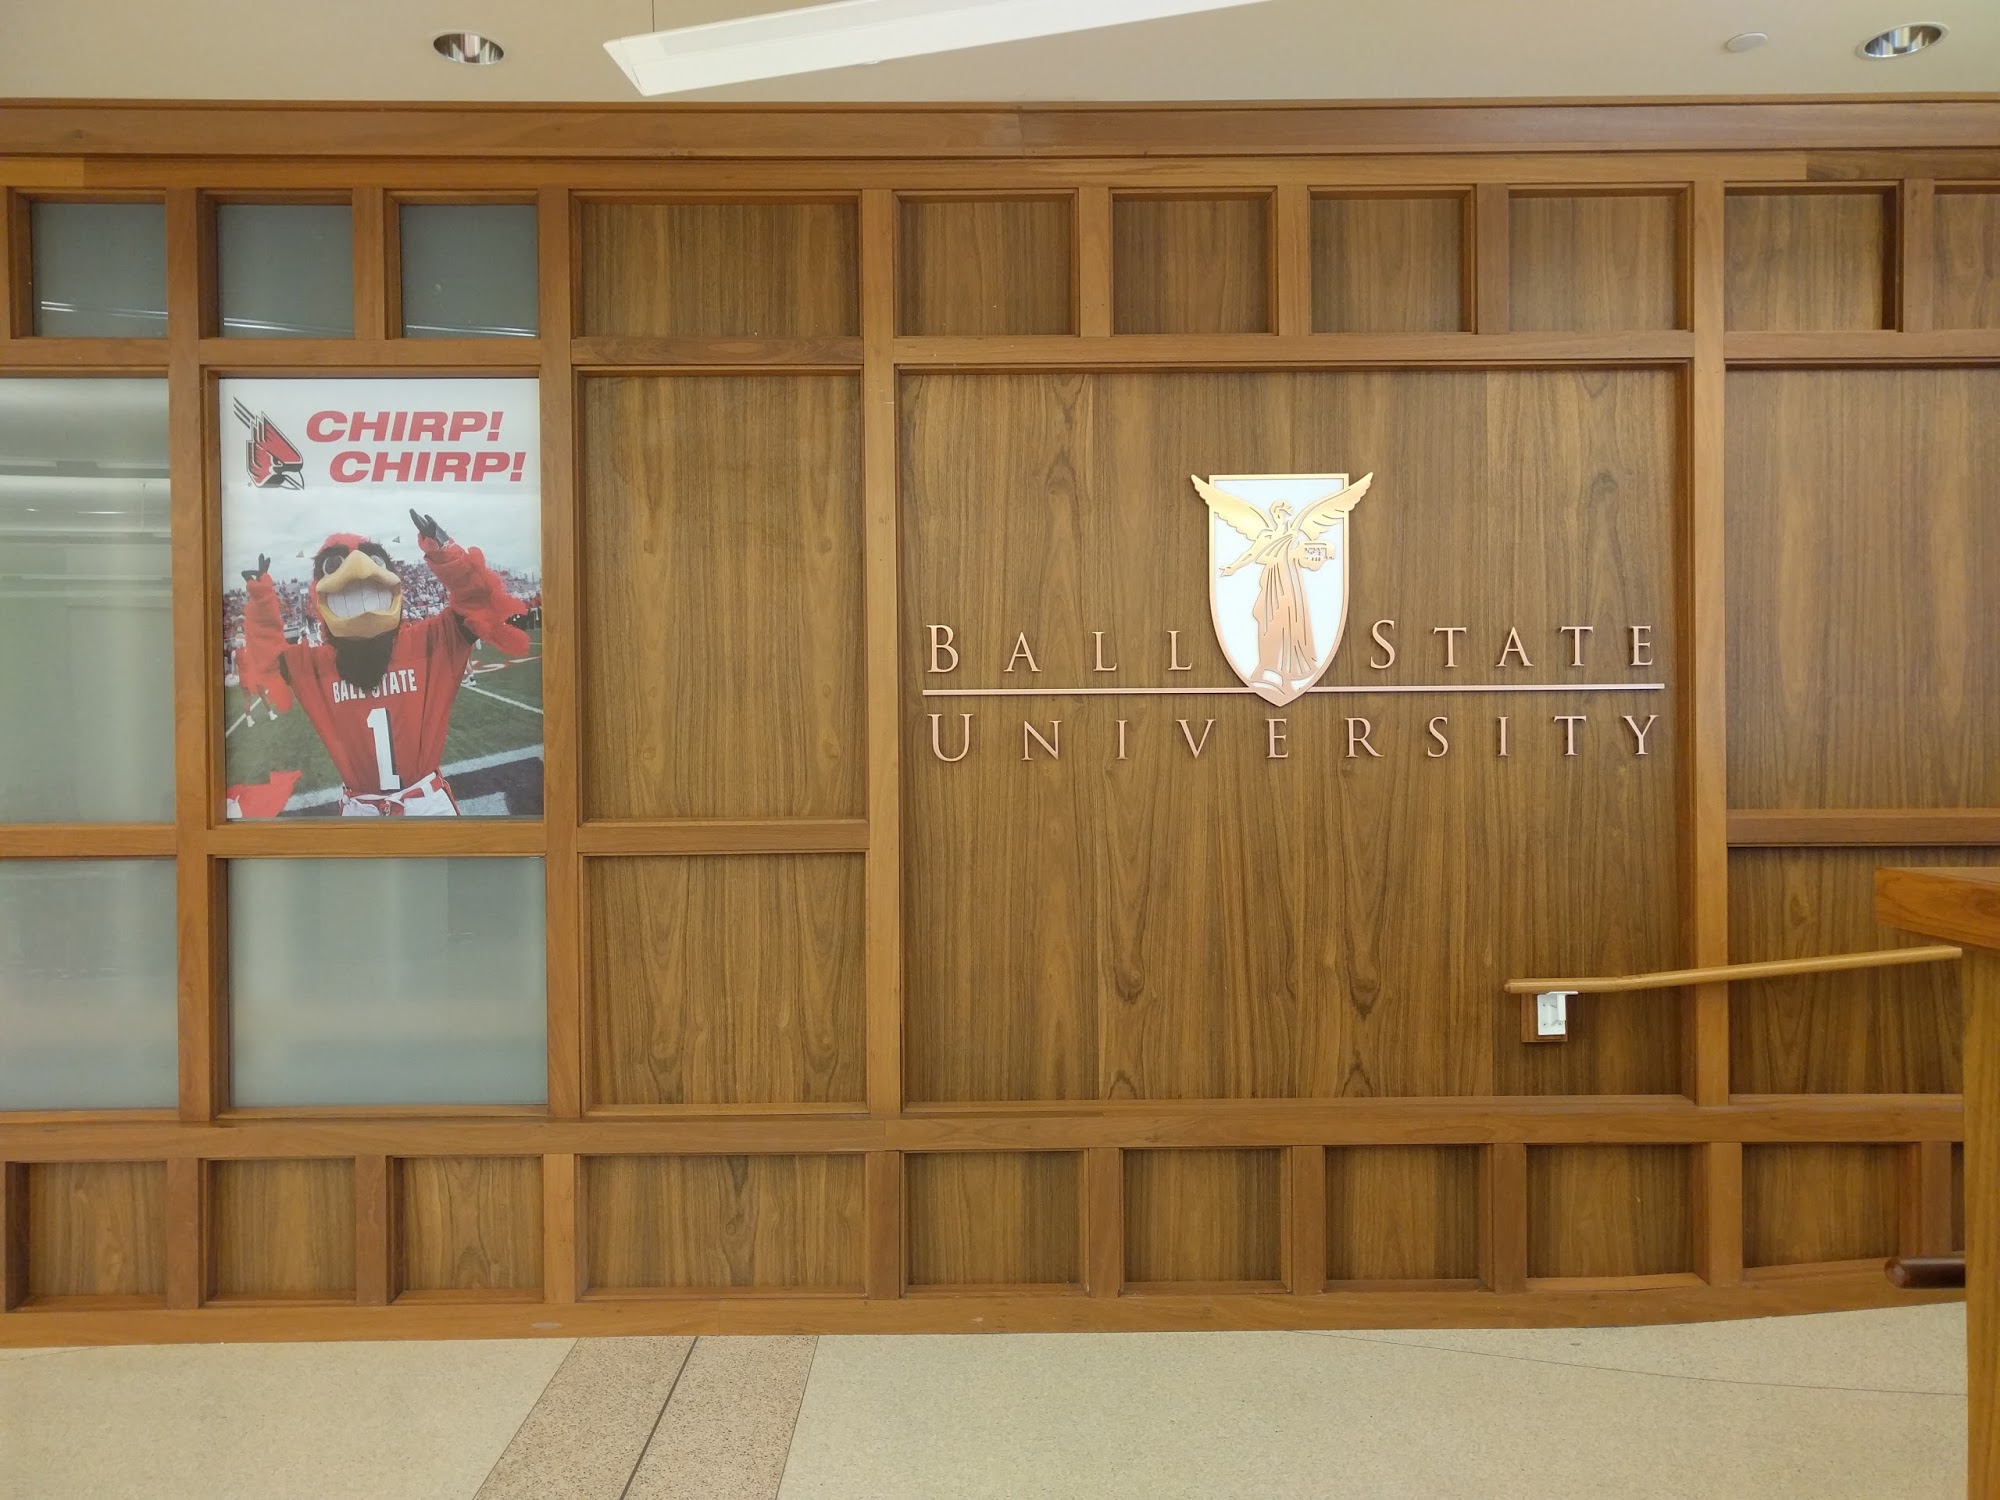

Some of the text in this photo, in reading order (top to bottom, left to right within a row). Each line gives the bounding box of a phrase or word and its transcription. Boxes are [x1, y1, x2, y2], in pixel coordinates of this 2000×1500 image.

[306, 410, 504, 443] CHIRP!
[329, 451, 527, 483] CHIRP!
[926, 619, 1655, 674] BALL STATE
[366, 707, 402, 791] 1
[927, 713, 1660, 762] UNIVERSITY
